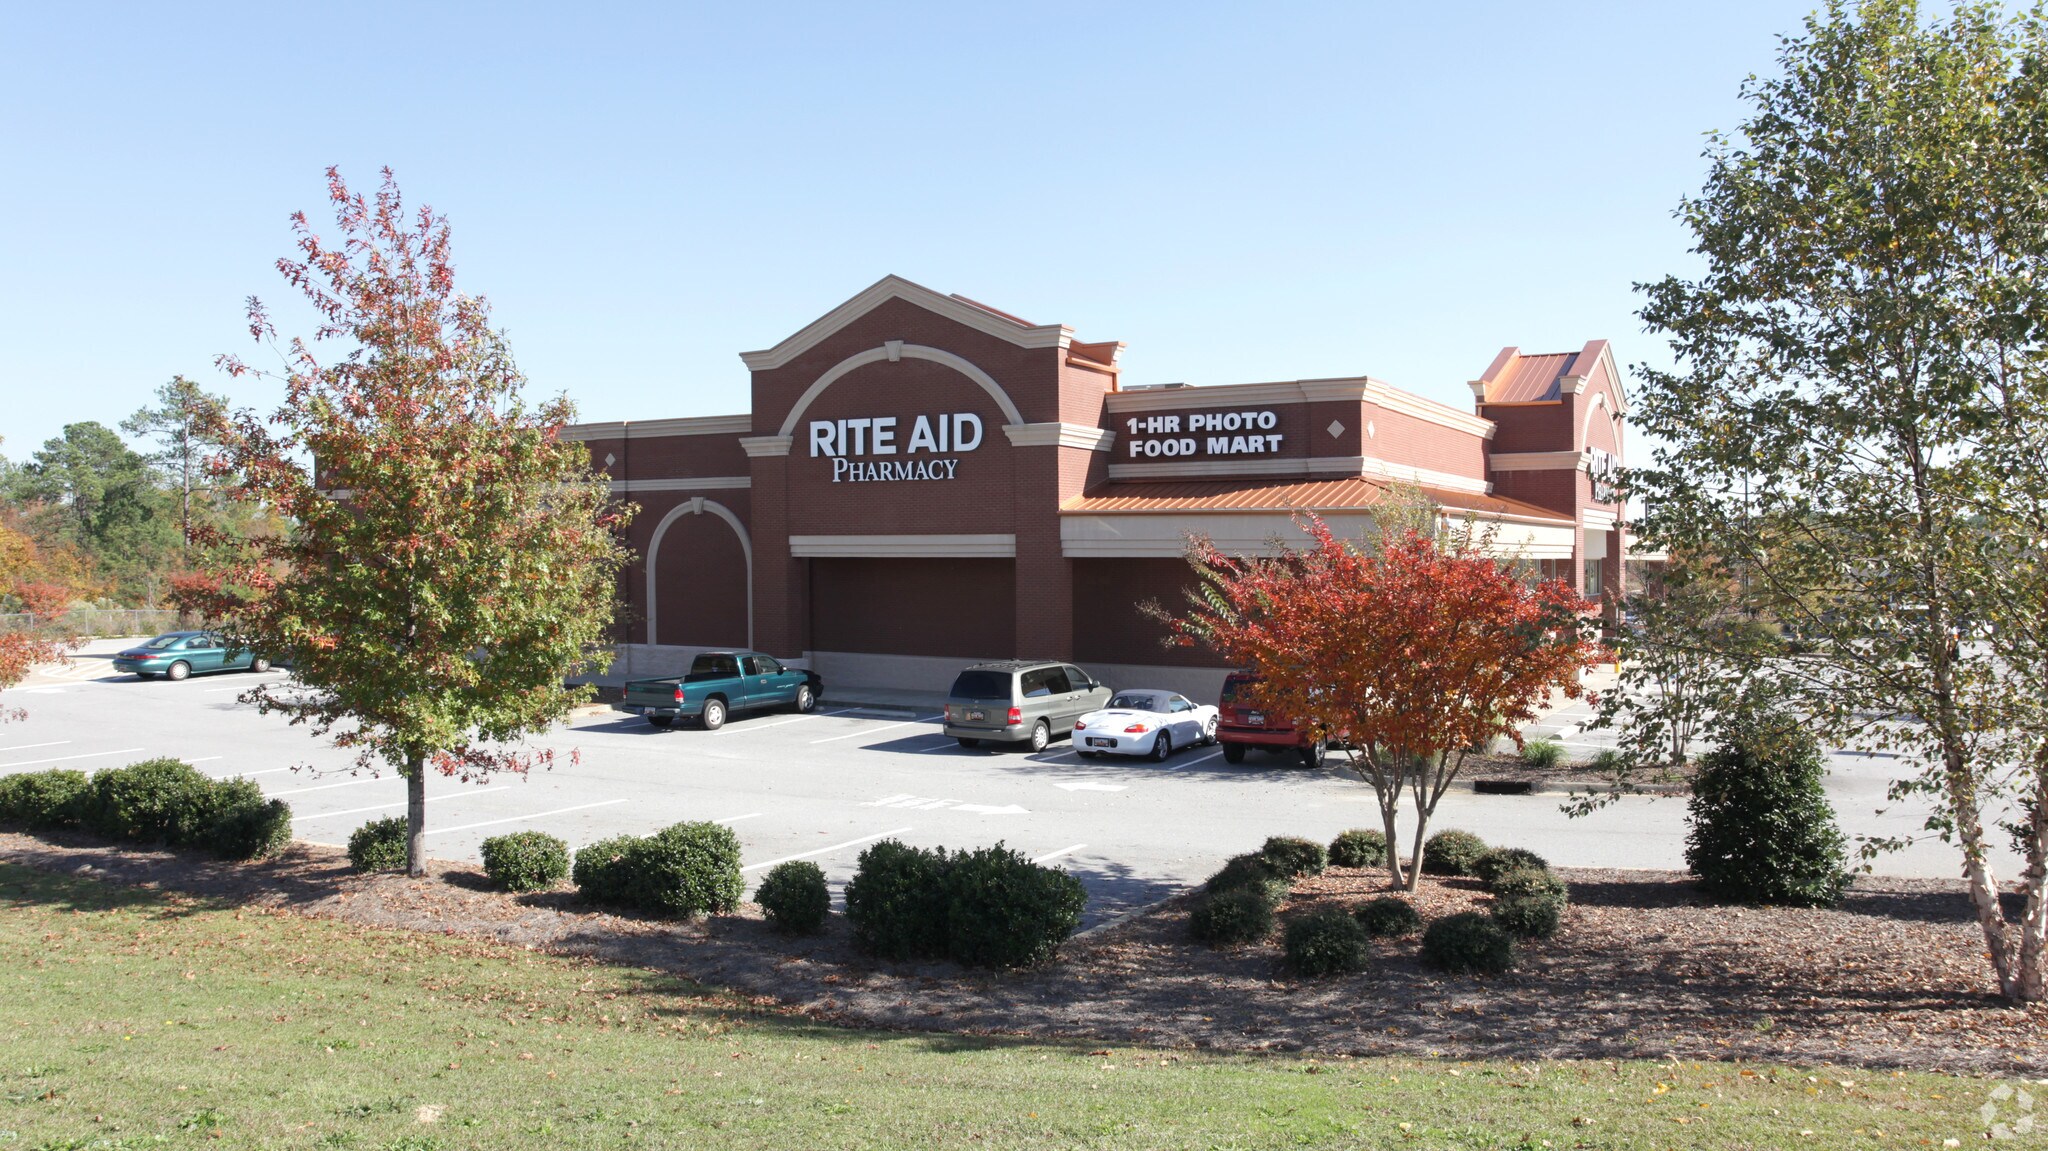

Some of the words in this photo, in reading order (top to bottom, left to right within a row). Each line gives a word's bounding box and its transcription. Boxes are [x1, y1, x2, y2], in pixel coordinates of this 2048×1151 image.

[1126, 415, 1180, 434] 1-HR
[1189, 411, 1277, 432] PHOTO
[810, 417, 897, 457] RITE
[907, 413, 983, 453] AID
[1130, 438, 1196, 457] FOOD
[1207, 434, 1282, 455] MART
[832, 457, 958, 482] PHARMACY
